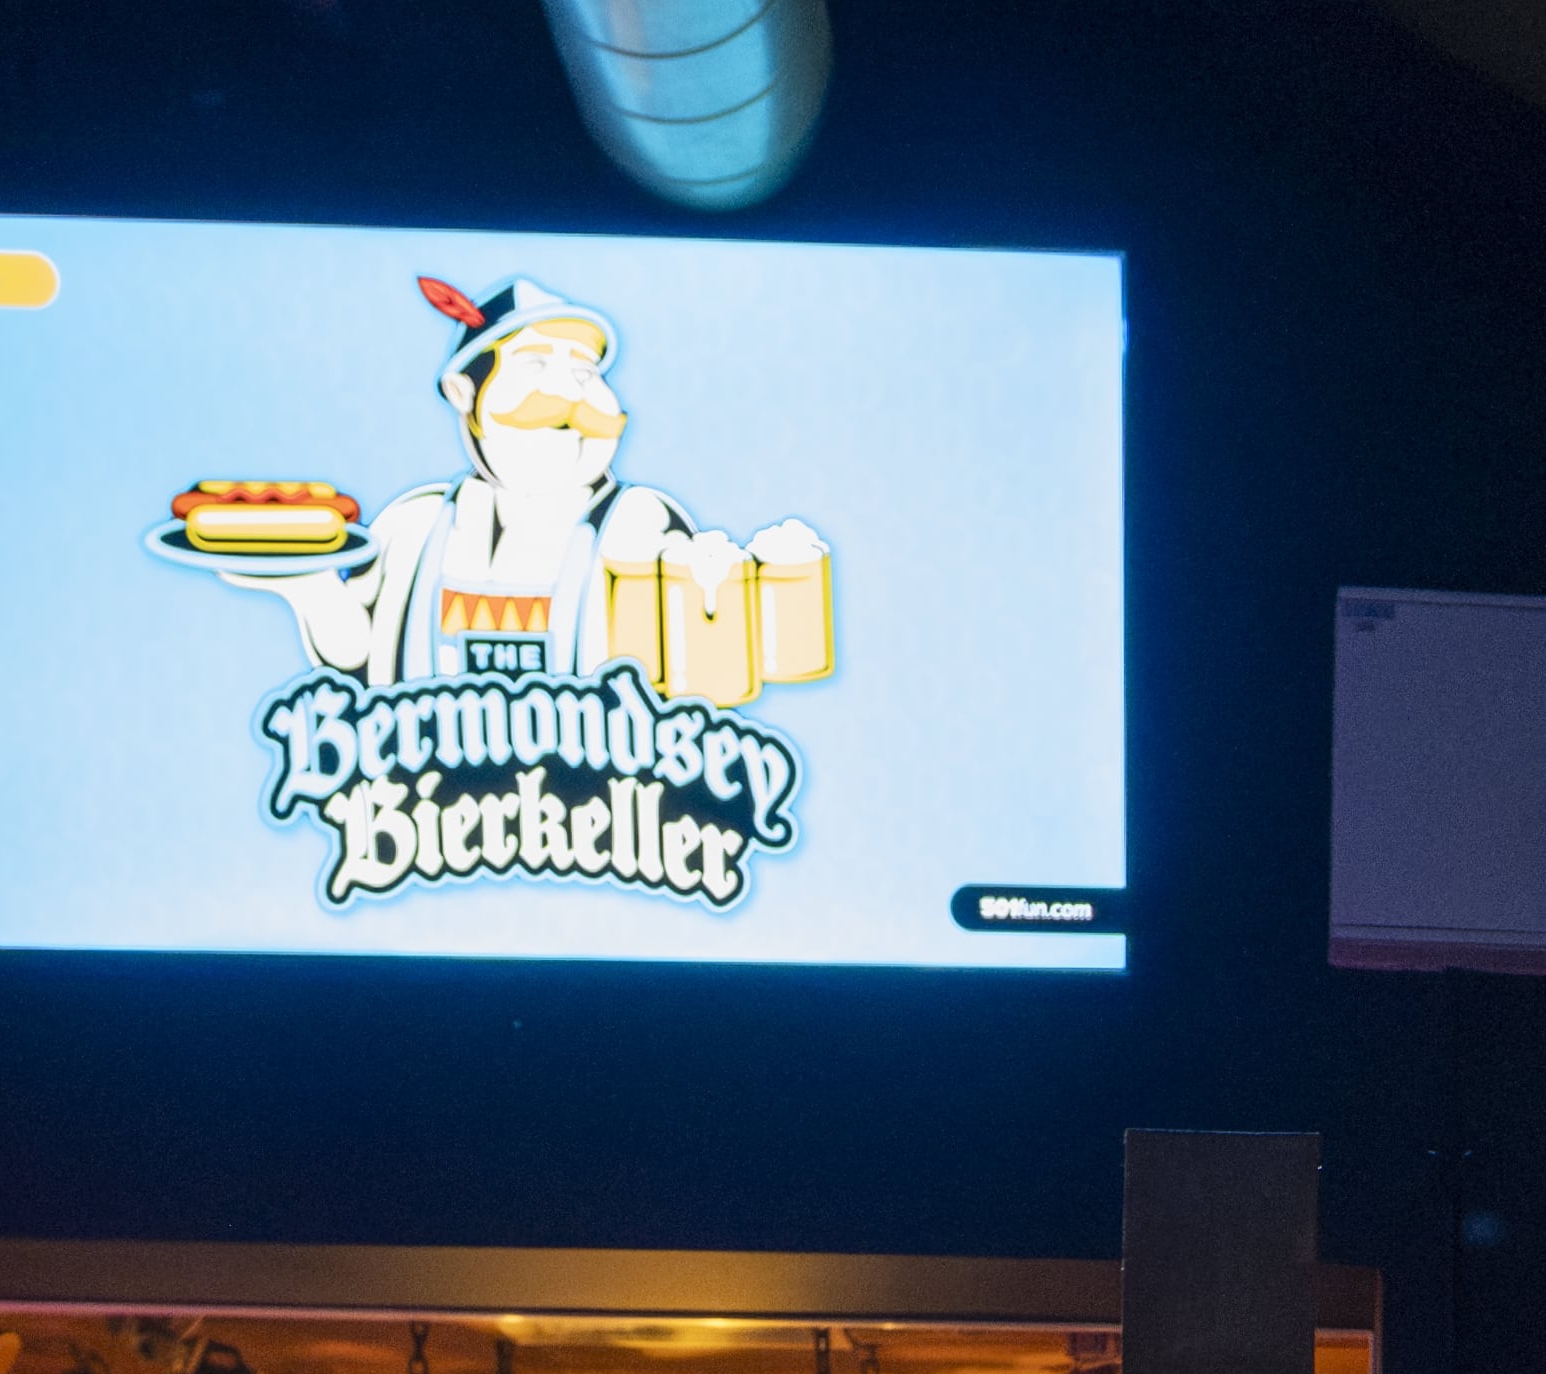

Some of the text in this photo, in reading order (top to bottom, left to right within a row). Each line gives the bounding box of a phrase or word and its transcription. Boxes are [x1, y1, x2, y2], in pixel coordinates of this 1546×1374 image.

[468, 642, 543, 671] THE
[267, 672, 792, 842] Bermondsey
[323, 766, 743, 900] Bierkeller
